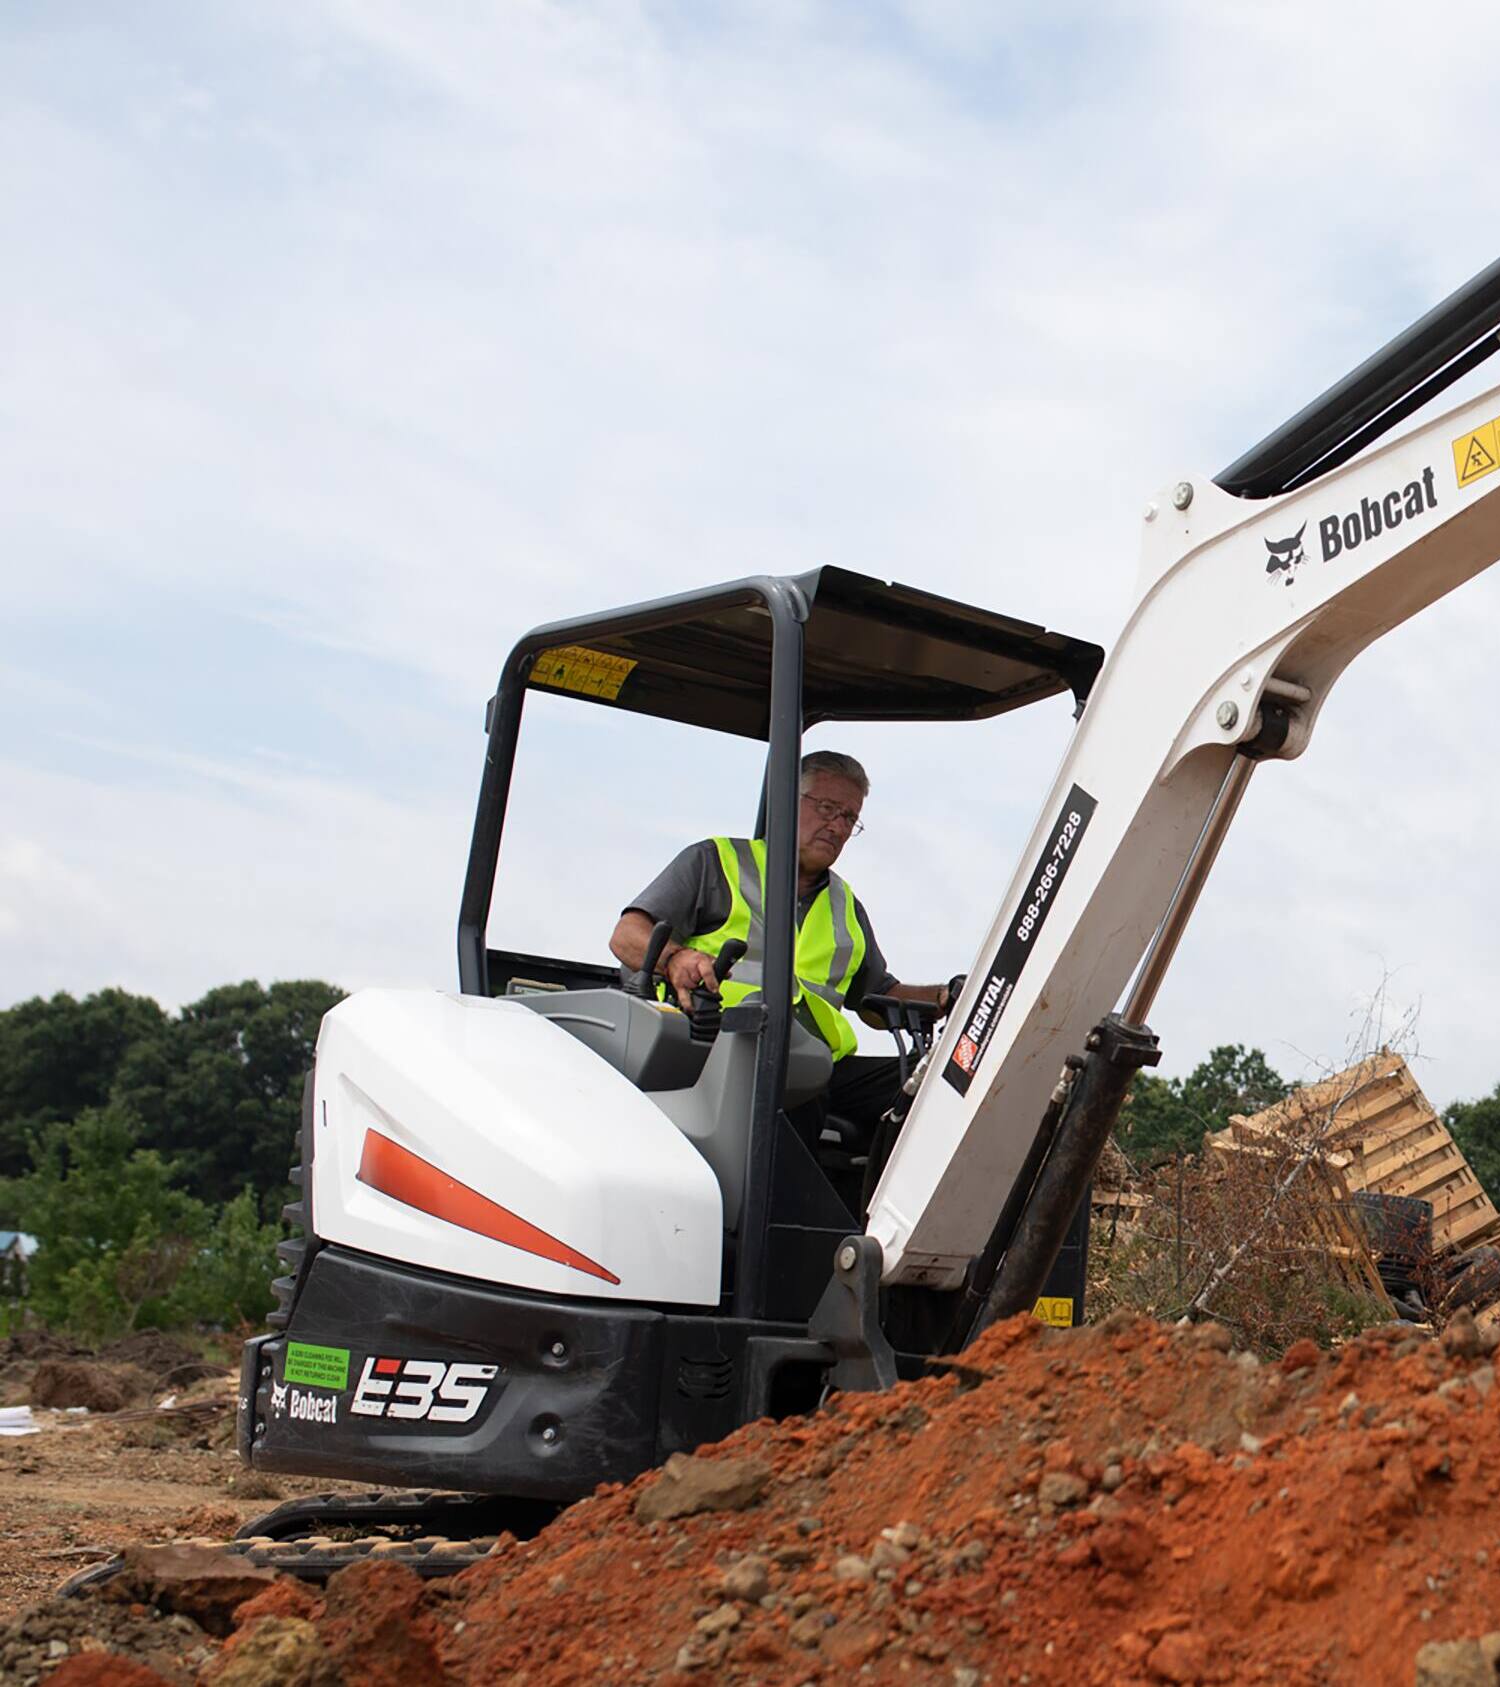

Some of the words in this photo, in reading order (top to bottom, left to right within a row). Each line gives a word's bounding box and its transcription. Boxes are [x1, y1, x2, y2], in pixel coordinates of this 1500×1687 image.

[1319, 466, 1438, 562] Bobcat
[1017, 811, 1081, 942] 888-266-7228
[967, 976, 1006, 1043] RENTAL
[290, 1389, 336, 1423] Bobcat
[351, 1357, 498, 1422] E35
